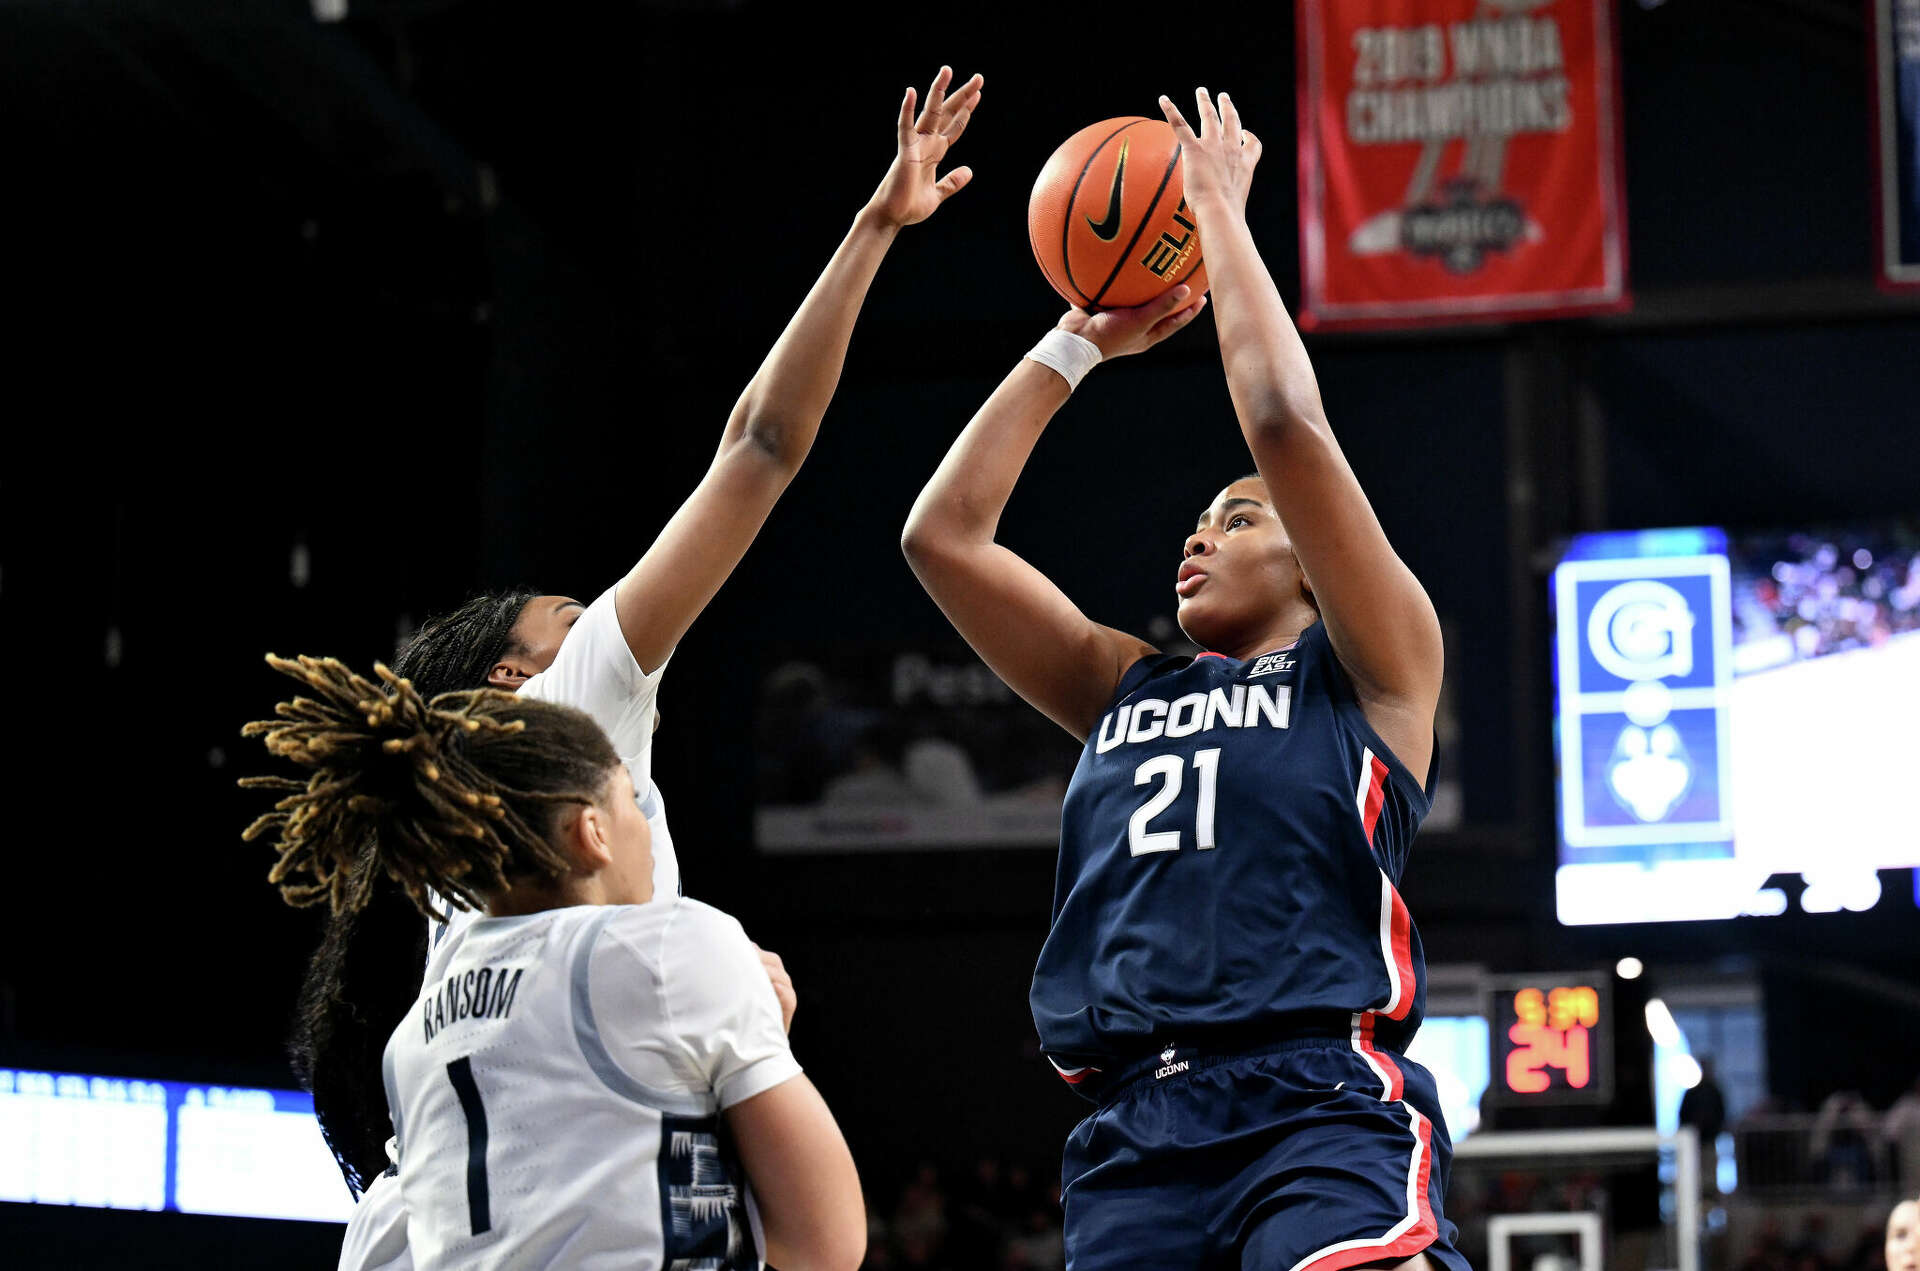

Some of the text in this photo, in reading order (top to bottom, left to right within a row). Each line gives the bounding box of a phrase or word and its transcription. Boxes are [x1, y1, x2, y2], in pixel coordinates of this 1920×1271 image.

[1449, 16, 1564, 74] WNBA
[1347, 76, 1572, 145] CHAMPIONS
[1250, 660, 1297, 675] EAST
[1255, 652, 1289, 667] BIG
[1095, 684, 1292, 754] UCONN
[1128, 748, 1221, 858] 21
[424, 967, 524, 1045] RANSOM
[1155, 1060, 1190, 1079] UCONN
[1506, 1024, 1590, 1094] 24
[446, 1056, 491, 1236] 1
